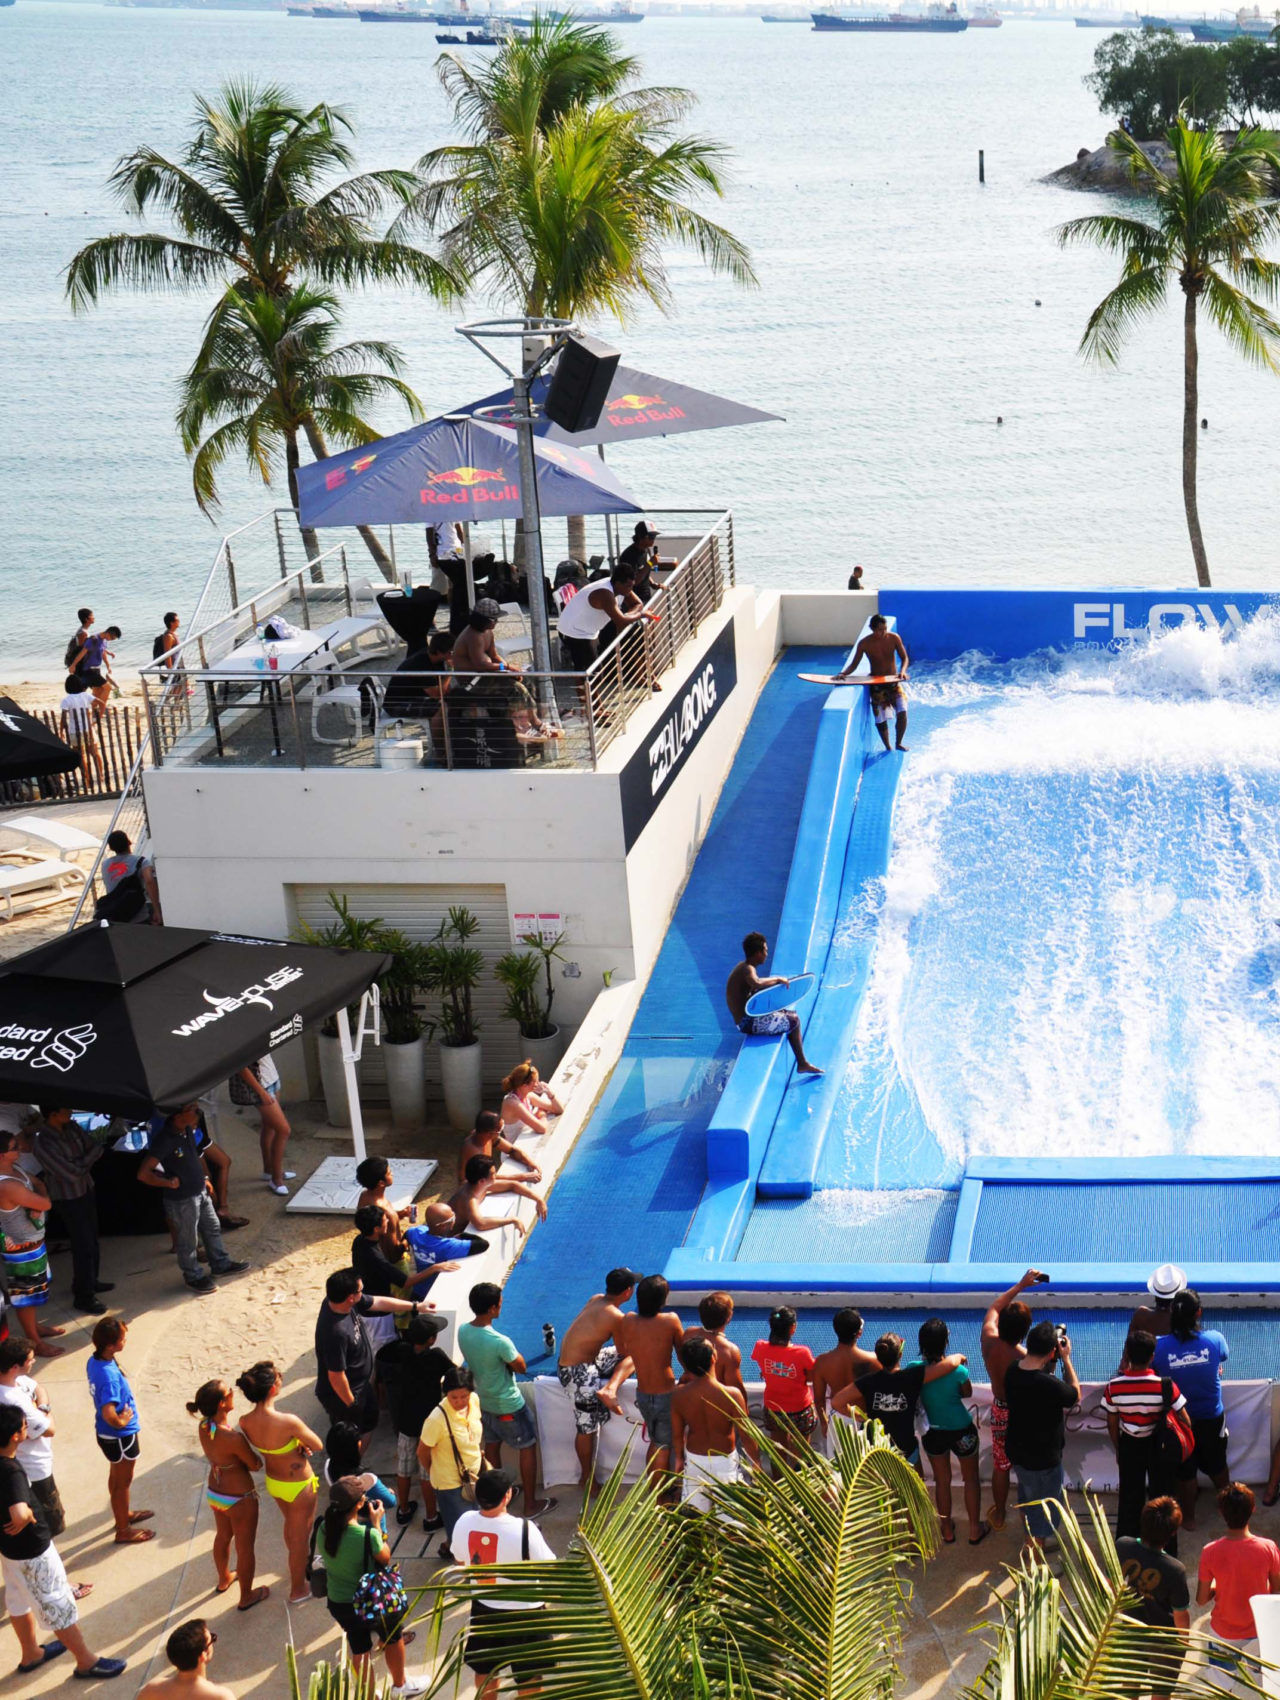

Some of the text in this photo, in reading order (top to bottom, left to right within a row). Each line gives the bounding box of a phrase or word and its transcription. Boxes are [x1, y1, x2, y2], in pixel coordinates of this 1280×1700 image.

[608, 406, 686, 428] Red Bull
[420, 485, 520, 505] Red Bull
